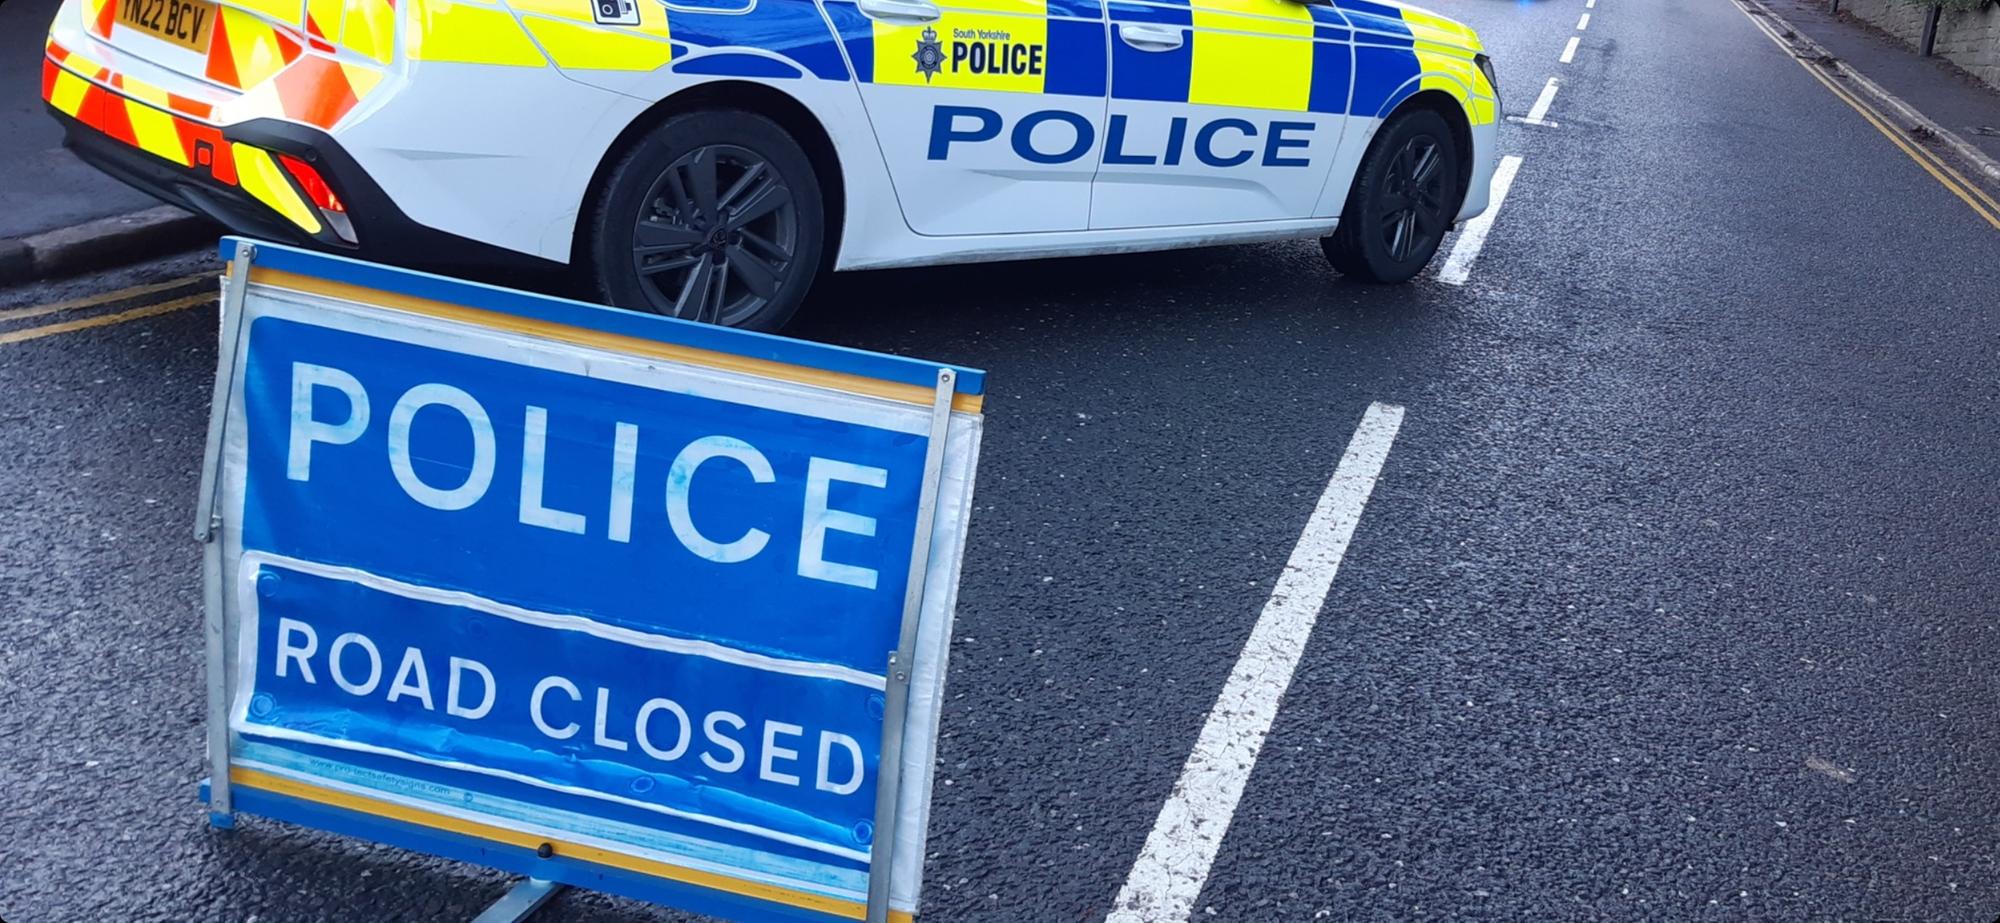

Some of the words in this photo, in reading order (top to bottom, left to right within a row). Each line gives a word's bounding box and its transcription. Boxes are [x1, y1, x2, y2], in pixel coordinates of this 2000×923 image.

[165, 0, 205, 43] BCV
[953, 28, 975, 39] South
[977, 29, 1010, 41] Yorkshire
[952, 41, 1042, 75] POLICE
[927, 105, 1316, 168] POLICE
[286, 361, 889, 590] POLICE
[275, 616, 496, 720] ROAD
[529, 675, 865, 796] CLOSED
